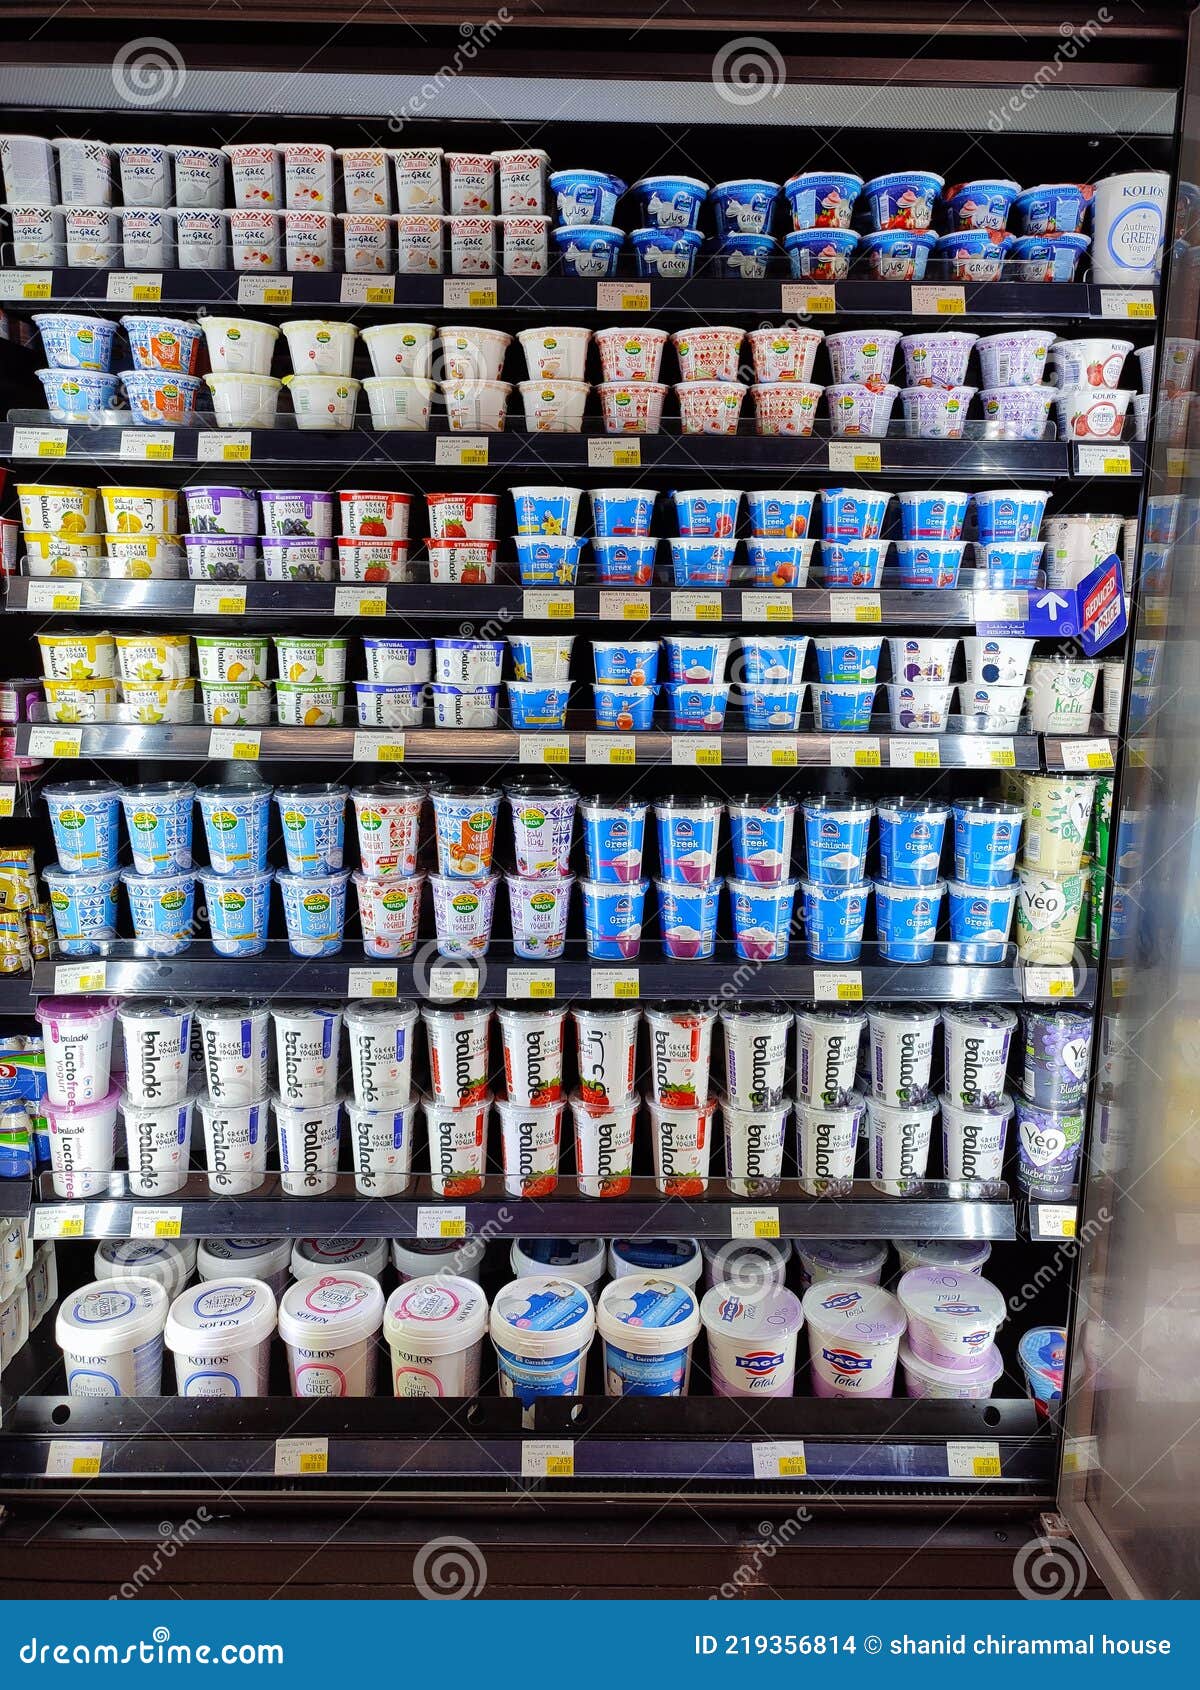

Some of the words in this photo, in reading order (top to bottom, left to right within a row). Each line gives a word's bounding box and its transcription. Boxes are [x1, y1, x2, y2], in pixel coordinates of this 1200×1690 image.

[1123, 184, 1166, 198] KOLIOS
[1085, 576, 1116, 622] REDUCED
[604, 840, 633, 849] Greek
[671, 840, 698, 849] Greek
[741, 838, 768, 847] Greek
[905, 842, 933, 852] Greek
[986, 842, 1012, 852] Greek
[1024, 891, 1058, 912] Yeo
[1024, 1127, 1059, 1151] Yeo
[188, 1355, 229, 1366] KOLIOS
[740, 1355, 784, 1368] FAGE
[826, 1352, 872, 1369] FAGE
[746, 1374, 775, 1389] Total
[832, 1373, 863, 1388] Total
